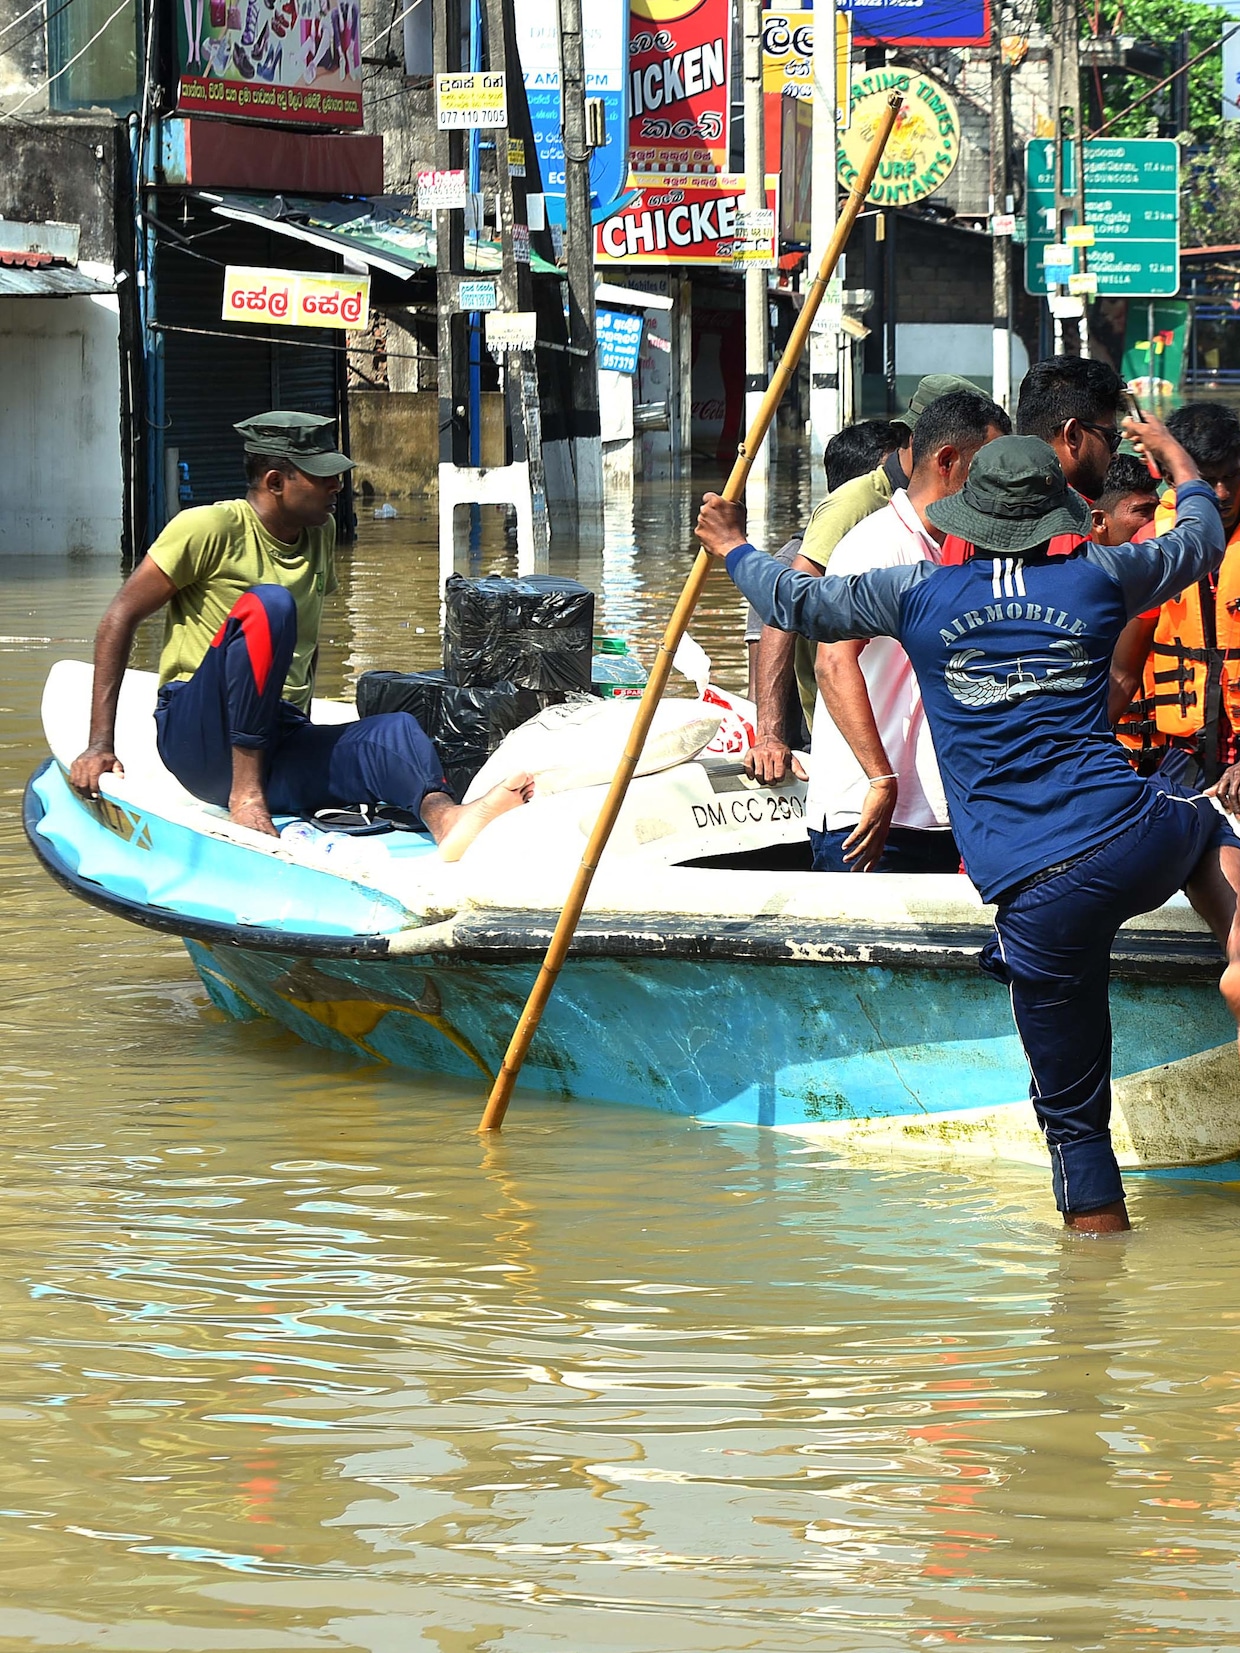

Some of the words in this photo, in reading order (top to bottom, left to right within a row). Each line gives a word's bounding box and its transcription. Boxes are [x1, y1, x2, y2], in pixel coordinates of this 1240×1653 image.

[534, 72, 559, 85] AM
[586, 74, 609, 86] PM
[629, 38, 725, 118] ICKEN
[440, 111, 458, 124] 077
[462, 110, 479, 123] 110
[482, 109, 505, 122] 7005
[851, 73, 910, 103] RTING
[916, 80, 955, 136] TIMES
[837, 150, 952, 202] CCUNTANTS
[879, 160, 917, 179] URF
[602, 193, 746, 258] CHICKE
[1095, 224, 1130, 234] LOMBO
[1096, 275, 1131, 284] WELLA
[231, 285, 289, 318] සේල්
[302, 290, 362, 323] සේල්
[603, 353, 635, 370] 957379
[938, 602, 1088, 647] AIRMOBILE
[691, 801, 727, 829] DM
[731, 797, 763, 824] CC
